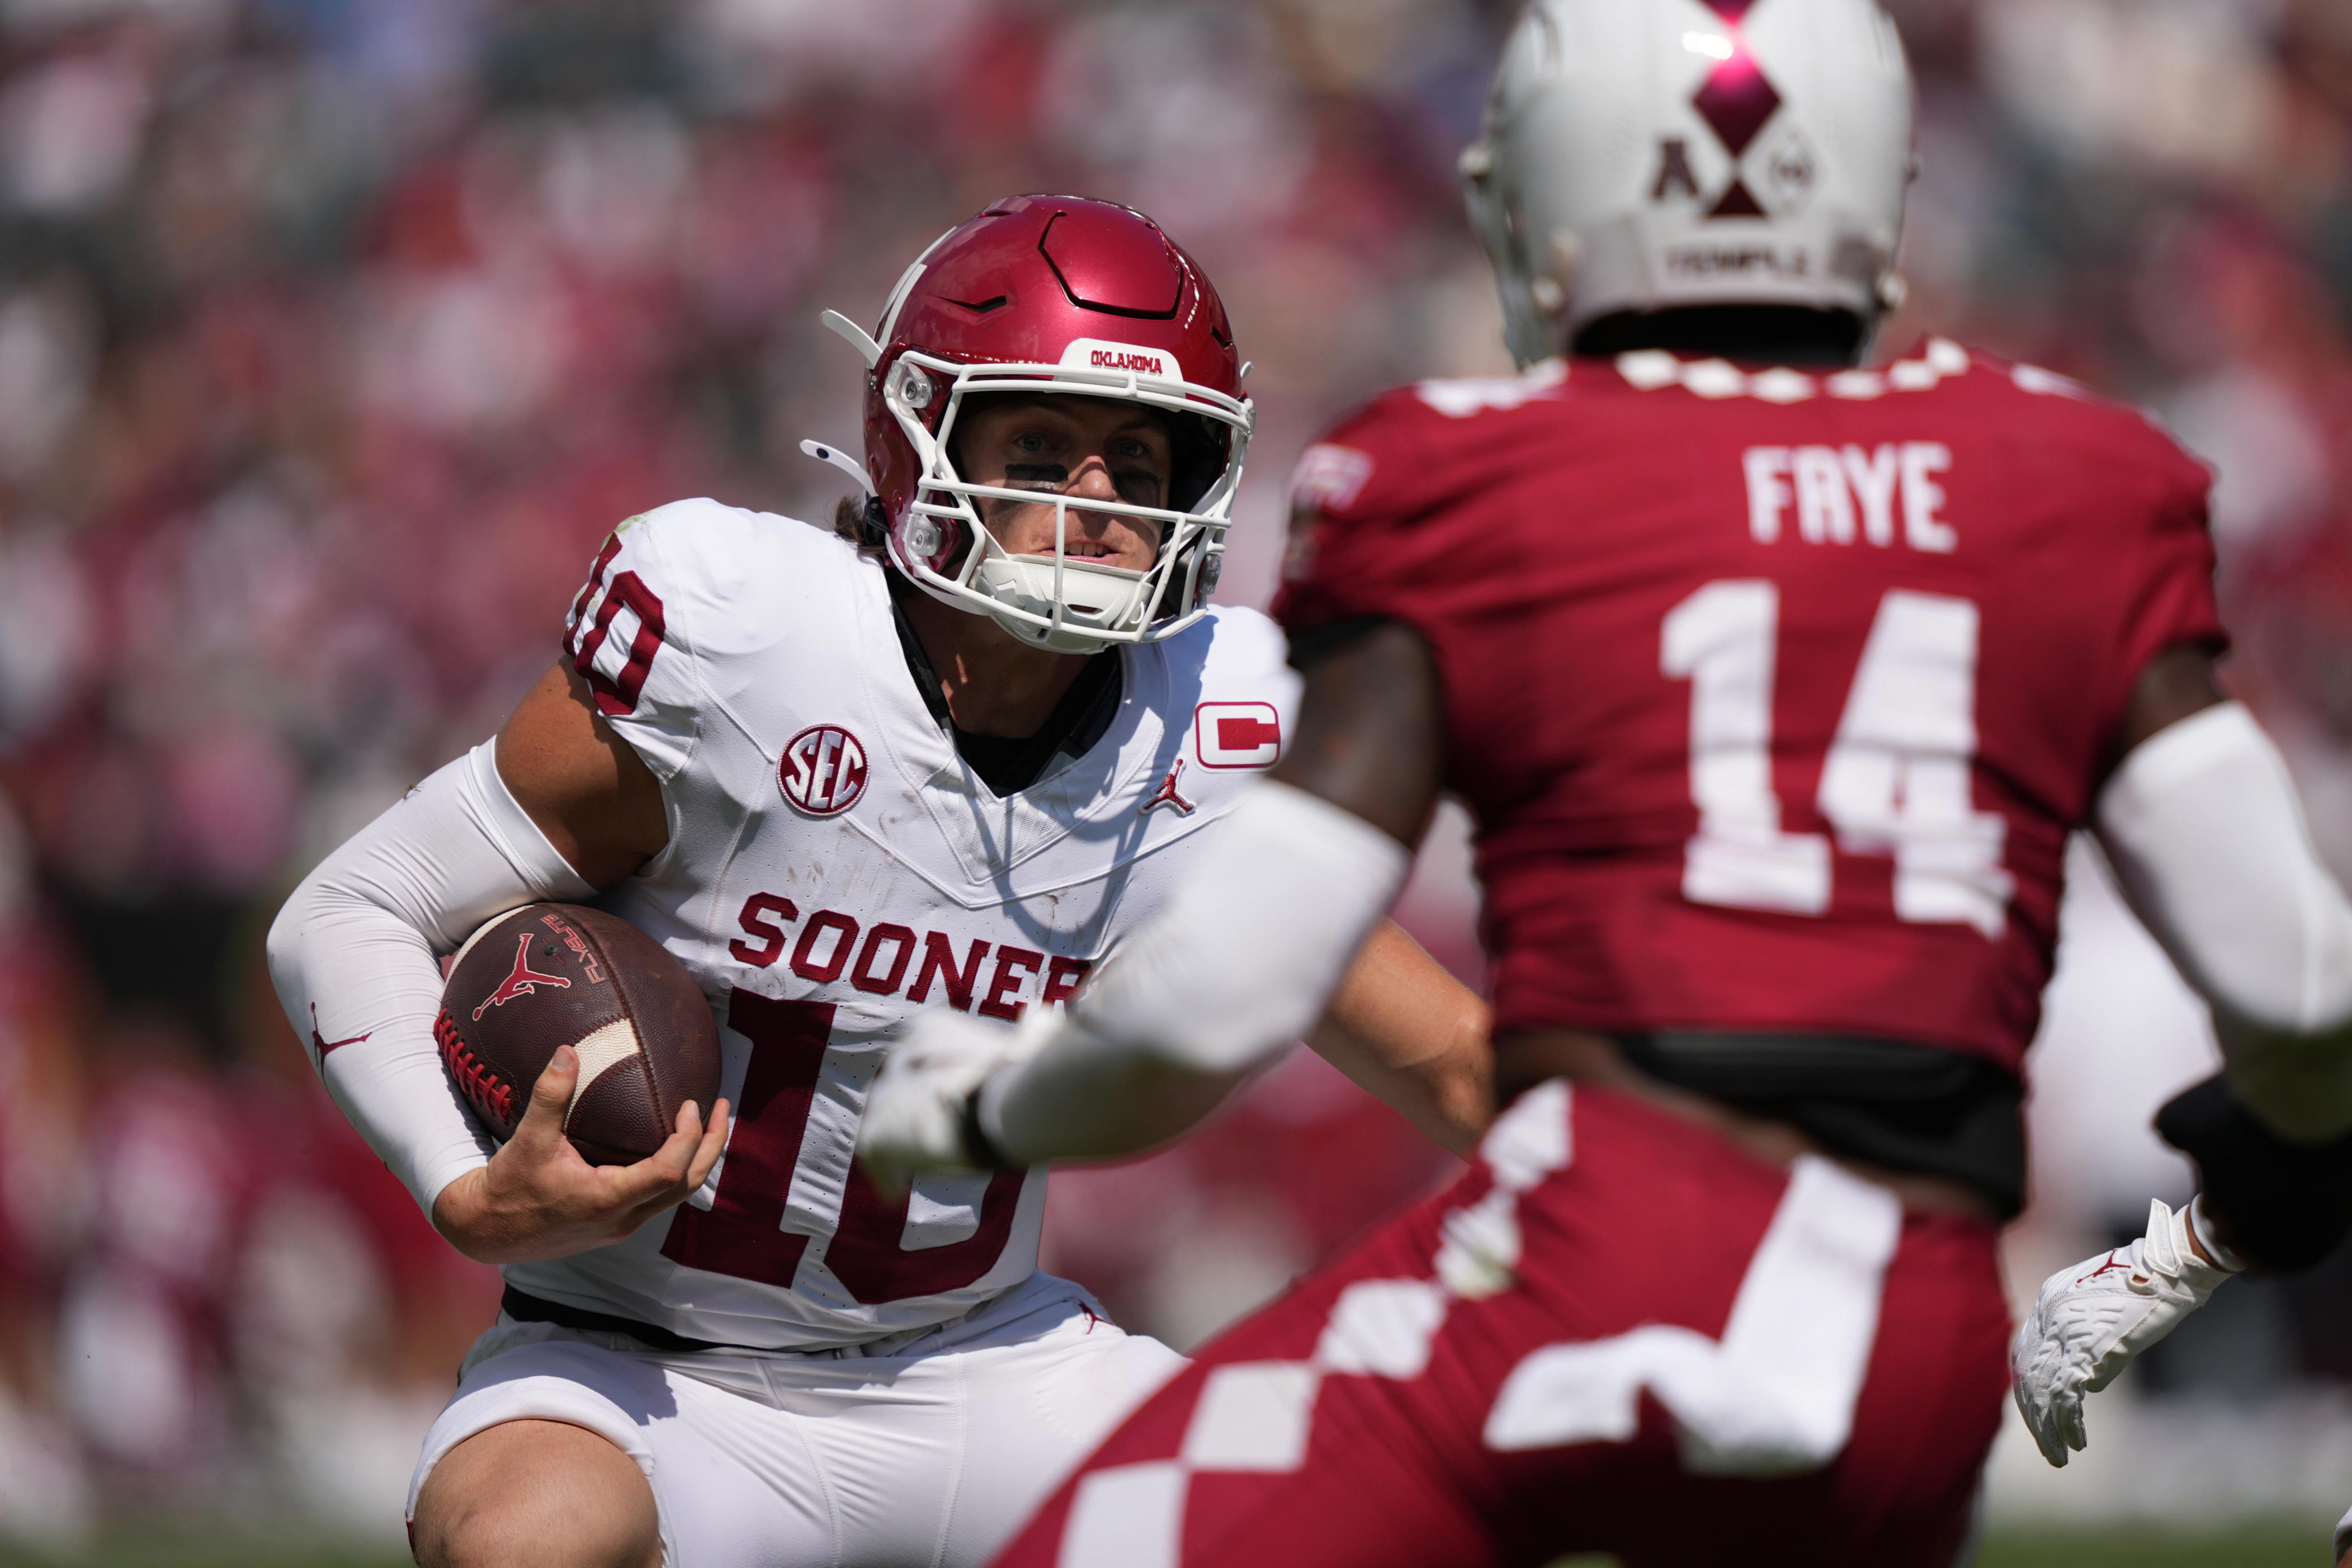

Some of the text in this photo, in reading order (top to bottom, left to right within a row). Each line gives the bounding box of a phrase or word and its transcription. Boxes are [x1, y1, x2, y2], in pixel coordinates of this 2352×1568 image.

[1090, 350, 1163, 374] OKLAHOMA
[562, 531, 667, 715] 10
[785, 730, 863, 810] SEC
[1659, 579, 2015, 943] 14
